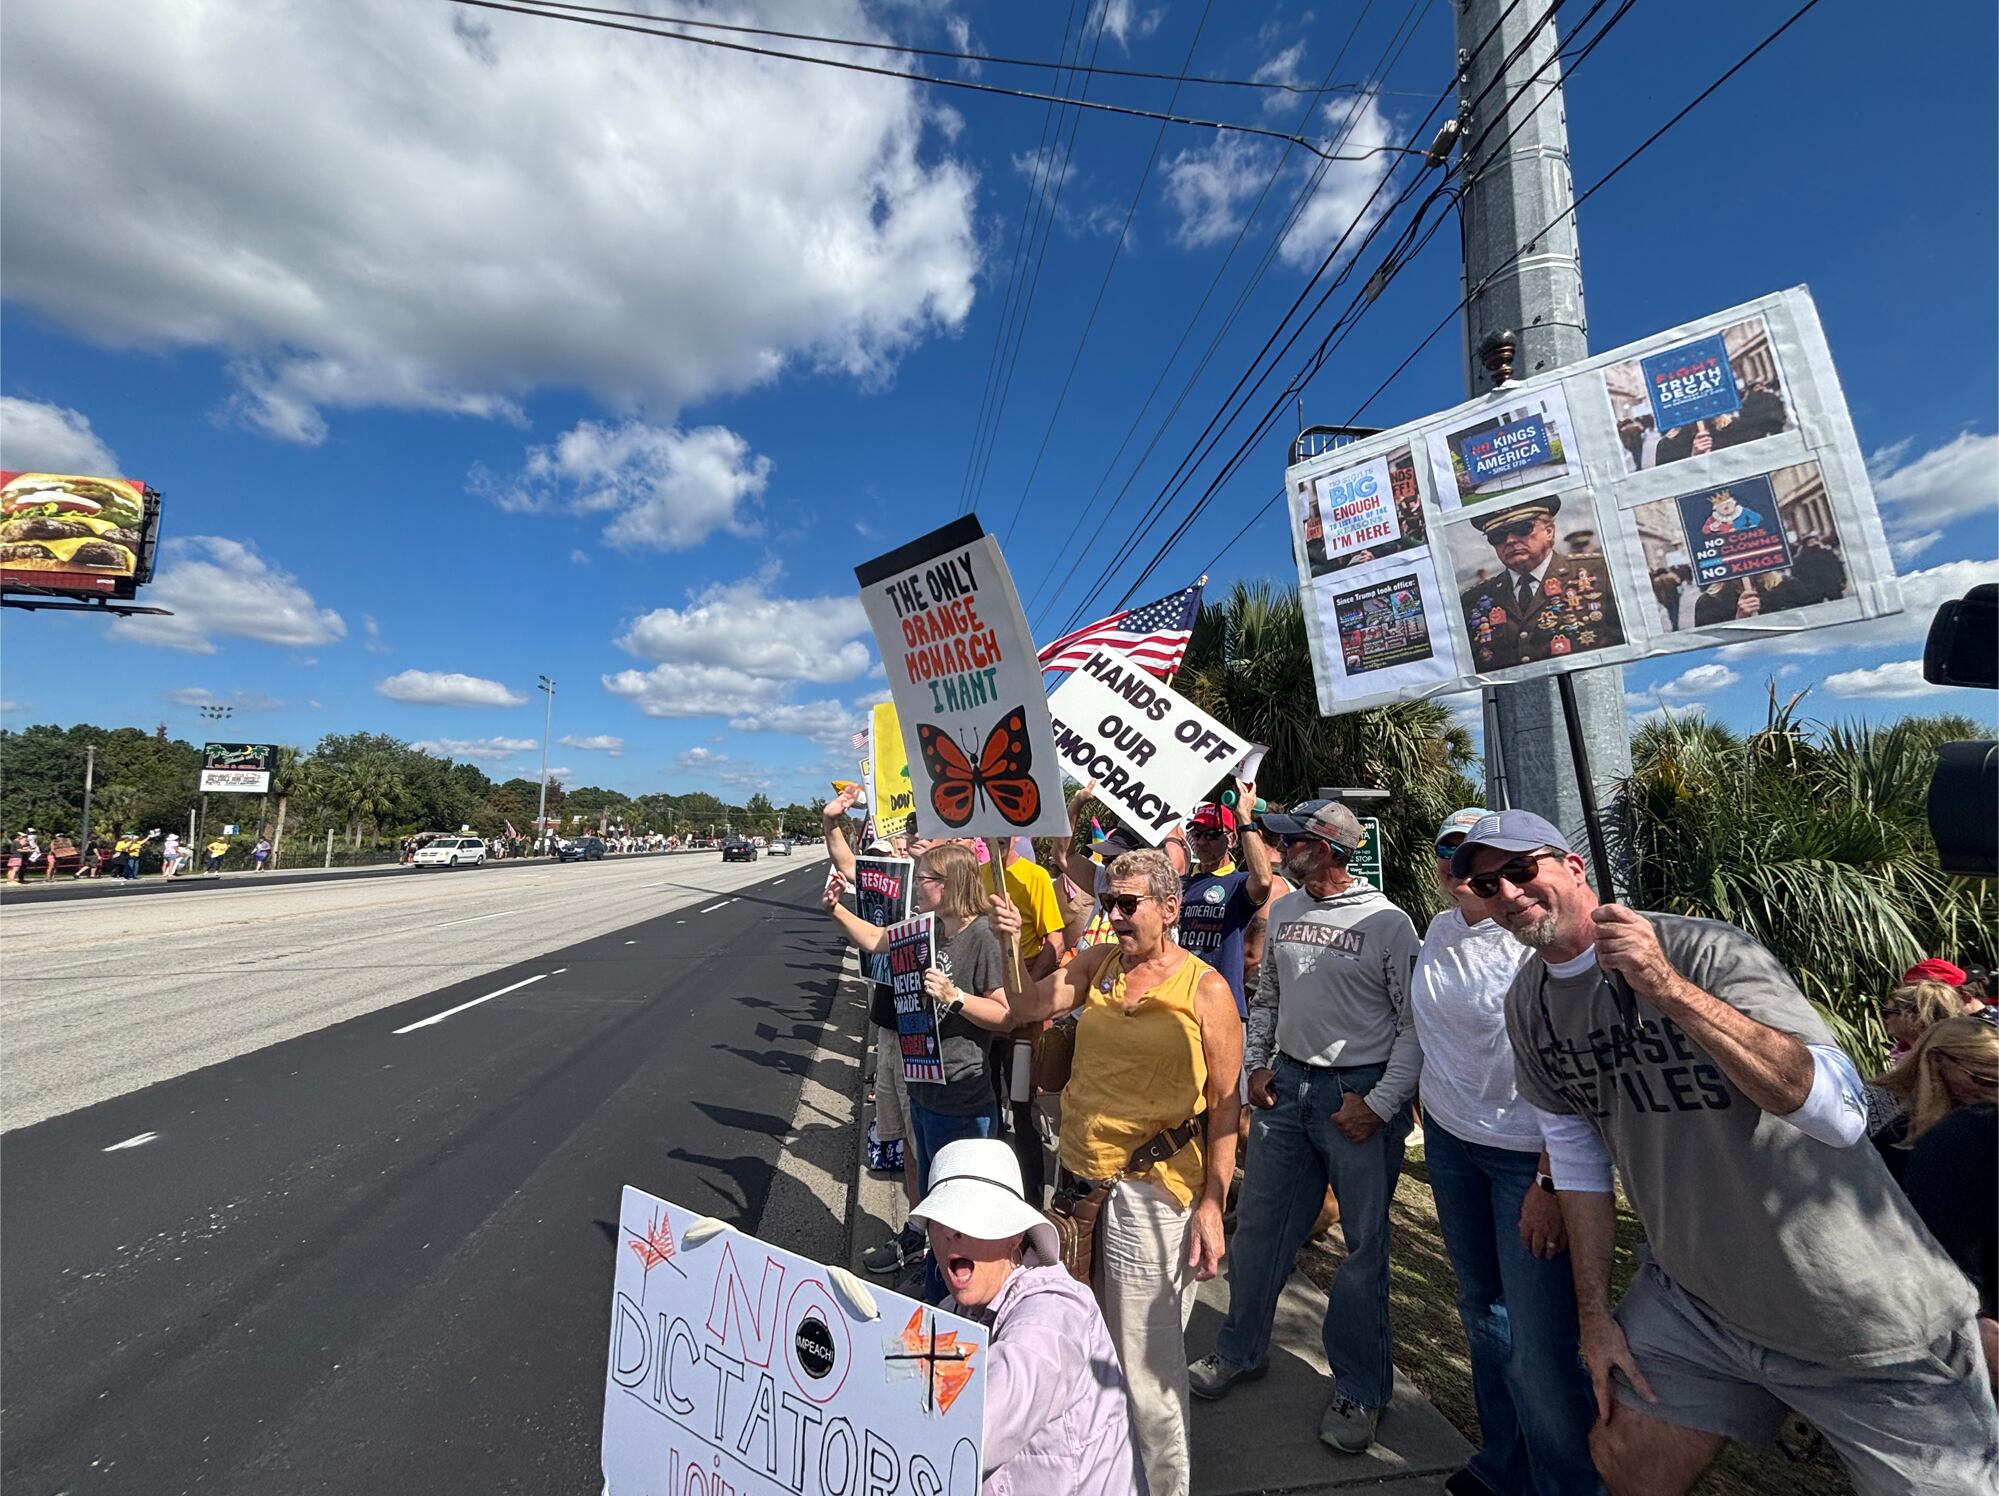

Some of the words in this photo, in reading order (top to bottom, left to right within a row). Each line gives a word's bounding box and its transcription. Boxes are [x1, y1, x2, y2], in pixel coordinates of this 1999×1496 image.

[1657, 366, 1721, 393] TRUTH
[1660, 376, 1721, 403] DECAY
[1472, 441, 1490, 455] NO
[1493, 426, 1537, 449] KINGS
[1476, 444, 1541, 472] AMERICA
[1492, 463, 1511, 475] SINCE
[1329, 475, 1378, 508] BIG
[1329, 522, 1337, 531] TO
[1338, 518, 1352, 528] LIST
[1353, 514, 1364, 523] ALL
[1366, 510, 1374, 518] OF
[1376, 506, 1388, 516] THE
[1333, 495, 1381, 522] ENOUGH
[1332, 533, 1352, 551] I'M
[1355, 521, 1391, 544] HERE
[1336, 516, 1383, 536] REASONS
[1704, 538, 1725, 549] NO
[1728, 529, 1767, 543] CONS
[1697, 549, 1717, 560] NO
[1721, 535, 1780, 554] CLOWNS
[1701, 566, 1727, 580] NO
[1731, 554, 1784, 574] KINGS
[886, 573, 928, 618] THE
[926, 551, 979, 603] ONLY
[1336, 596, 1354, 606] Since
[1354, 590, 1376, 601] Trump
[1376, 585, 1393, 595] took
[901, 596, 985, 649] ORANGE
[904, 629, 1002, 685] MONARCH
[1082, 651, 1172, 721] HANDS
[1174, 719, 1239, 764] OFF
[1097, 714, 1157, 768] OUR
[1049, 711, 1182, 831] EMOCRACY
[1355, 855, 1373, 863] STOP
[861, 872, 899, 898] RESIST!
[1184, 904, 1226, 919] AMERICA
[1180, 931, 1222, 947] AGAIN
[1277, 923, 1361, 952] CLEMSON
[890, 943, 917, 975] HATE
[893, 971, 922, 996] NEVER
[894, 993, 921, 1015] MADE
[1609, 1063, 1732, 1114] ILES
[704, 1240, 852, 1404] NO
